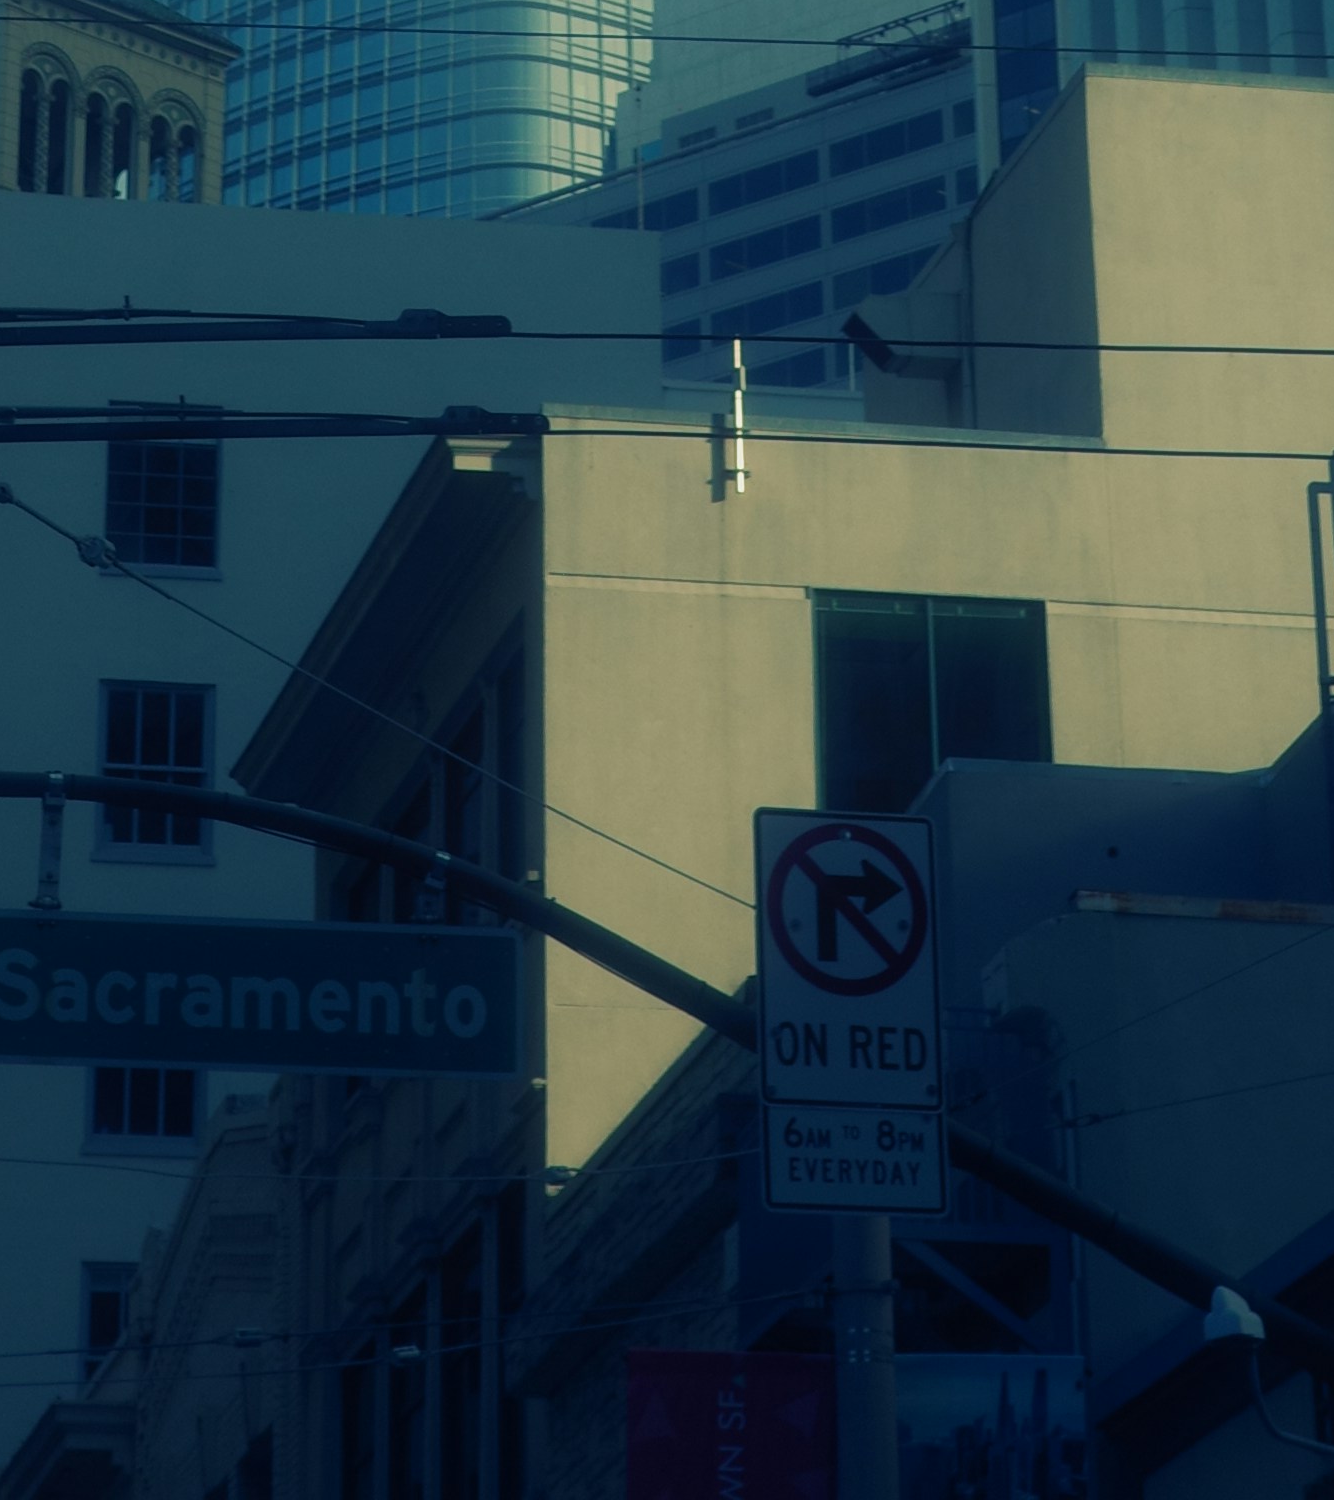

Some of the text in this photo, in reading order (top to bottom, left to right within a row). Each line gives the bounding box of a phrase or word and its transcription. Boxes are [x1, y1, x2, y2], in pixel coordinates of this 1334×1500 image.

[774, 1020, 928, 1073] ON RED
[783, 1116, 926, 1153] 6AM TO 8PM
[788, 1156, 923, 1187] EVERYDAY
[717, 1389, 748, 1432] SF
